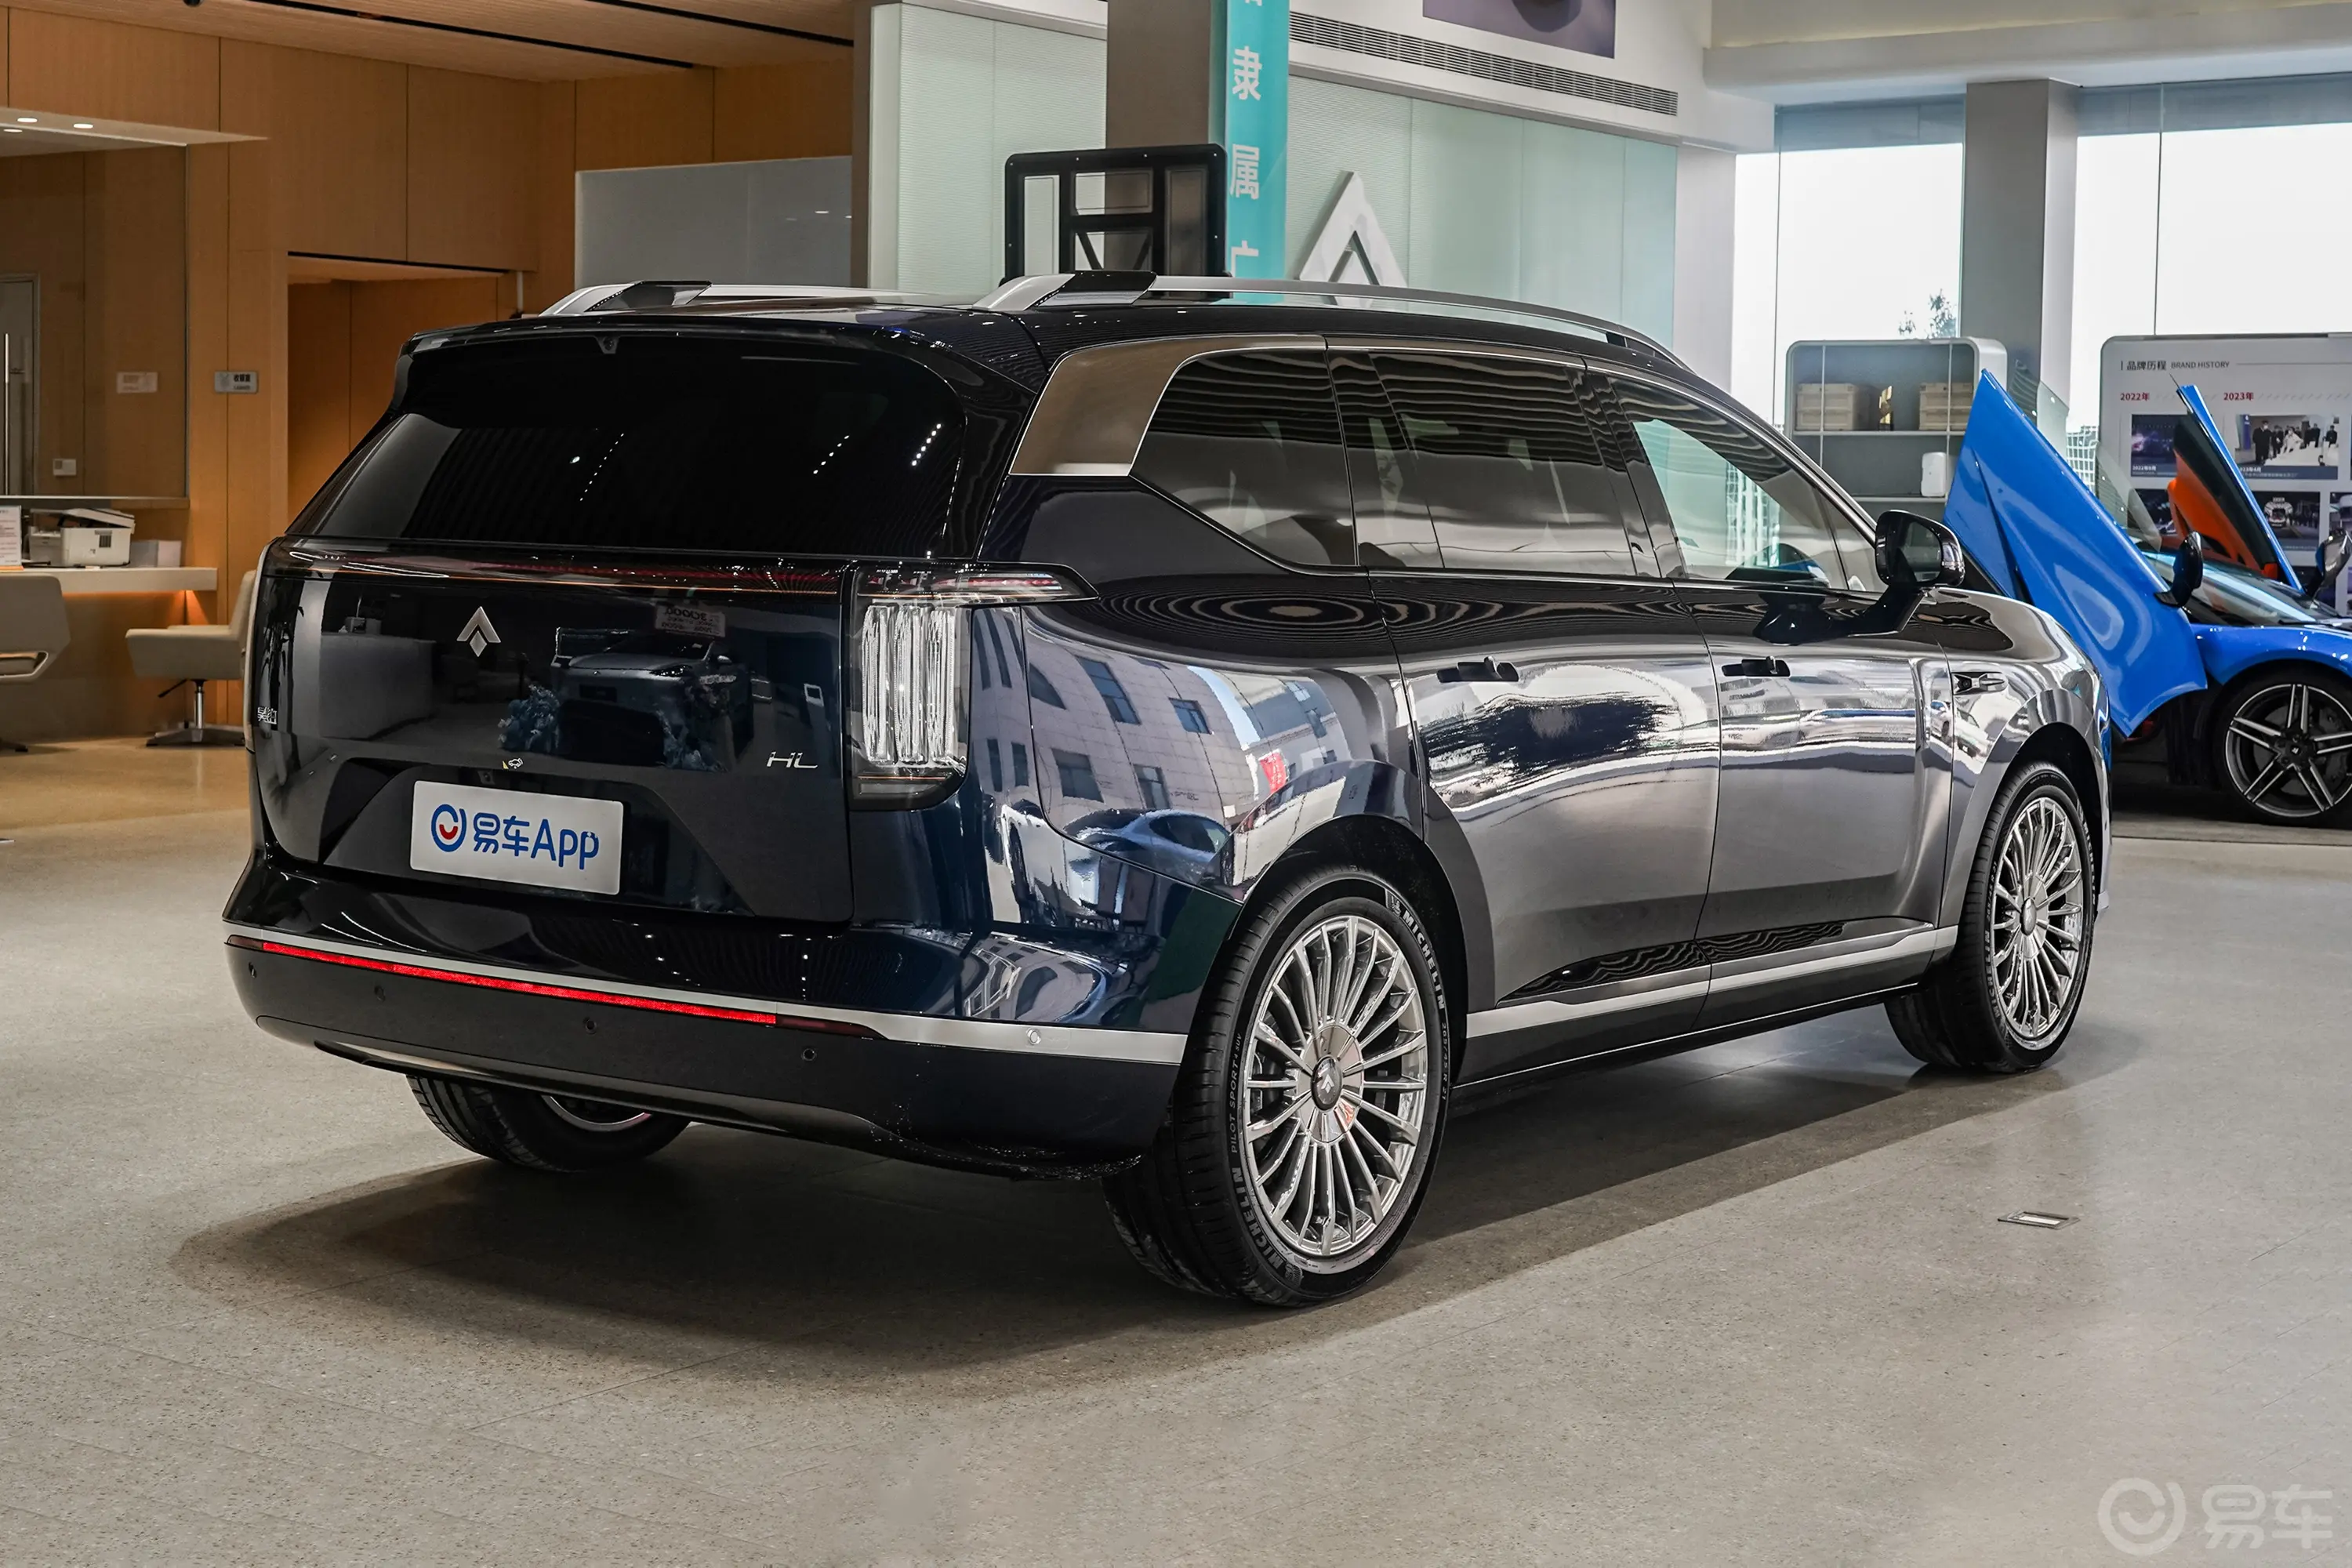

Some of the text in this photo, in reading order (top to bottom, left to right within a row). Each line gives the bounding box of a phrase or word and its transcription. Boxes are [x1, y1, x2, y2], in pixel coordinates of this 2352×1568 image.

[2126, 361, 2167, 371] 品牌历程
[2198, 361, 2230, 369] HISTORY
[2120, 393, 2150, 402] 2022年
[2223, 392, 2255, 401] 2023年
[766, 751, 818, 769] HL
[473, 812, 600, 870] 易车App
[1402, 909, 1446, 1010] MICHELIN
[1984, 930, 2002, 1018] MICHELIN
[1234, 1033, 1243, 1052] SUV
[1229, 1059, 1240, 1109] SPORT
[1229, 1112, 1238, 1153] PILOT
[1231, 1167, 1284, 1270] MICHELIN
